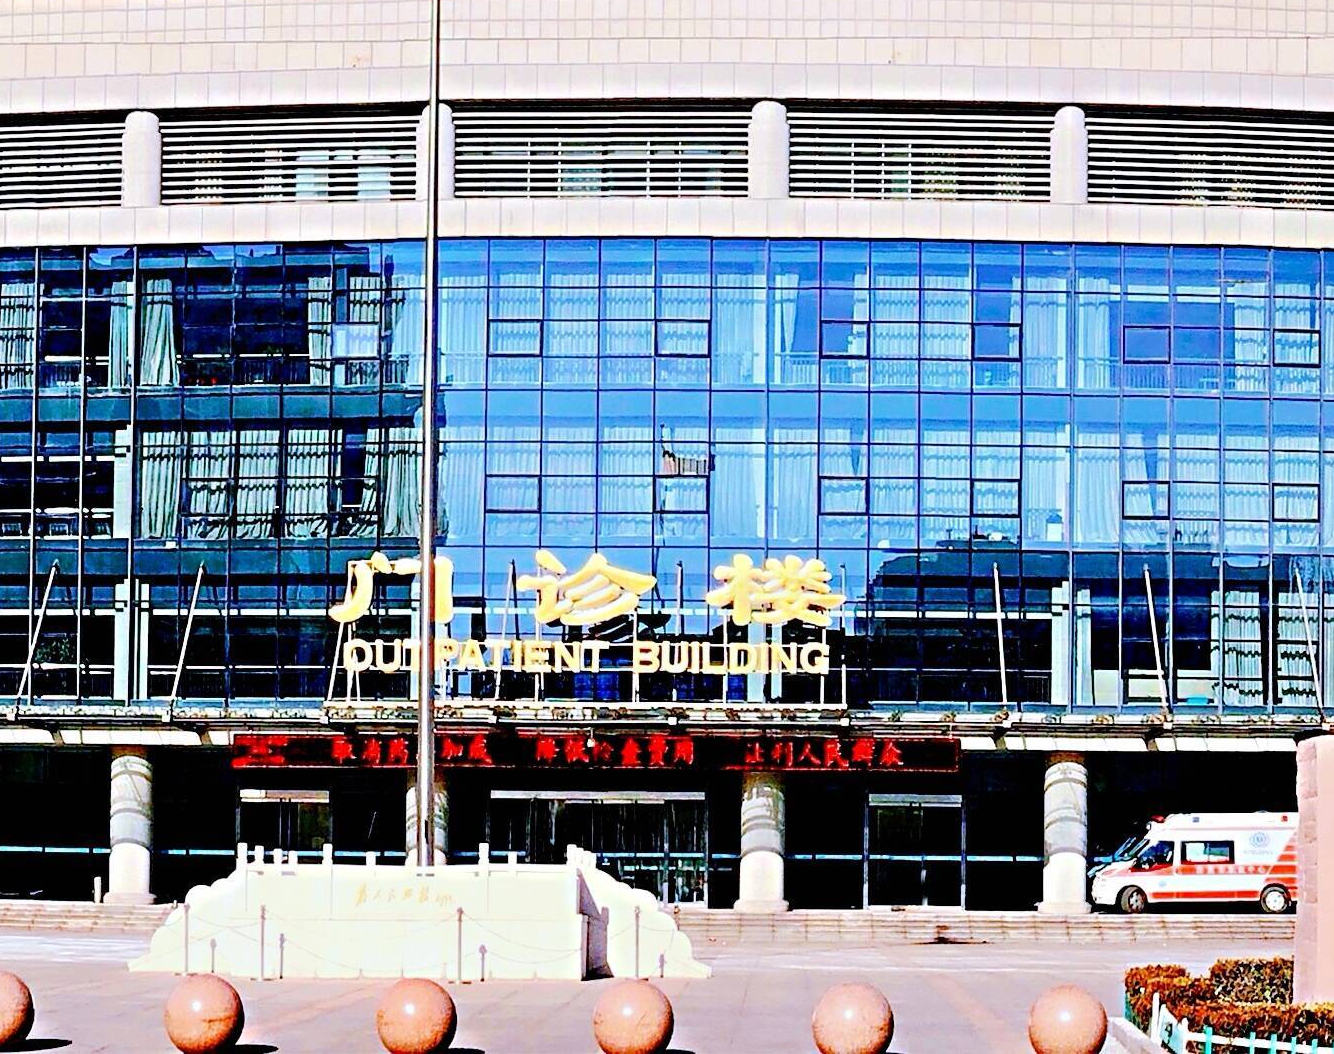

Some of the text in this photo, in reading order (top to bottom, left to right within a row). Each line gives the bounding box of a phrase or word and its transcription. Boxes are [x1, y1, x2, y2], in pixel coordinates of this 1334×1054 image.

[329, 550, 847, 627] 门诊楼
[342, 638, 830, 675] OUTPATIENT BUILDING
